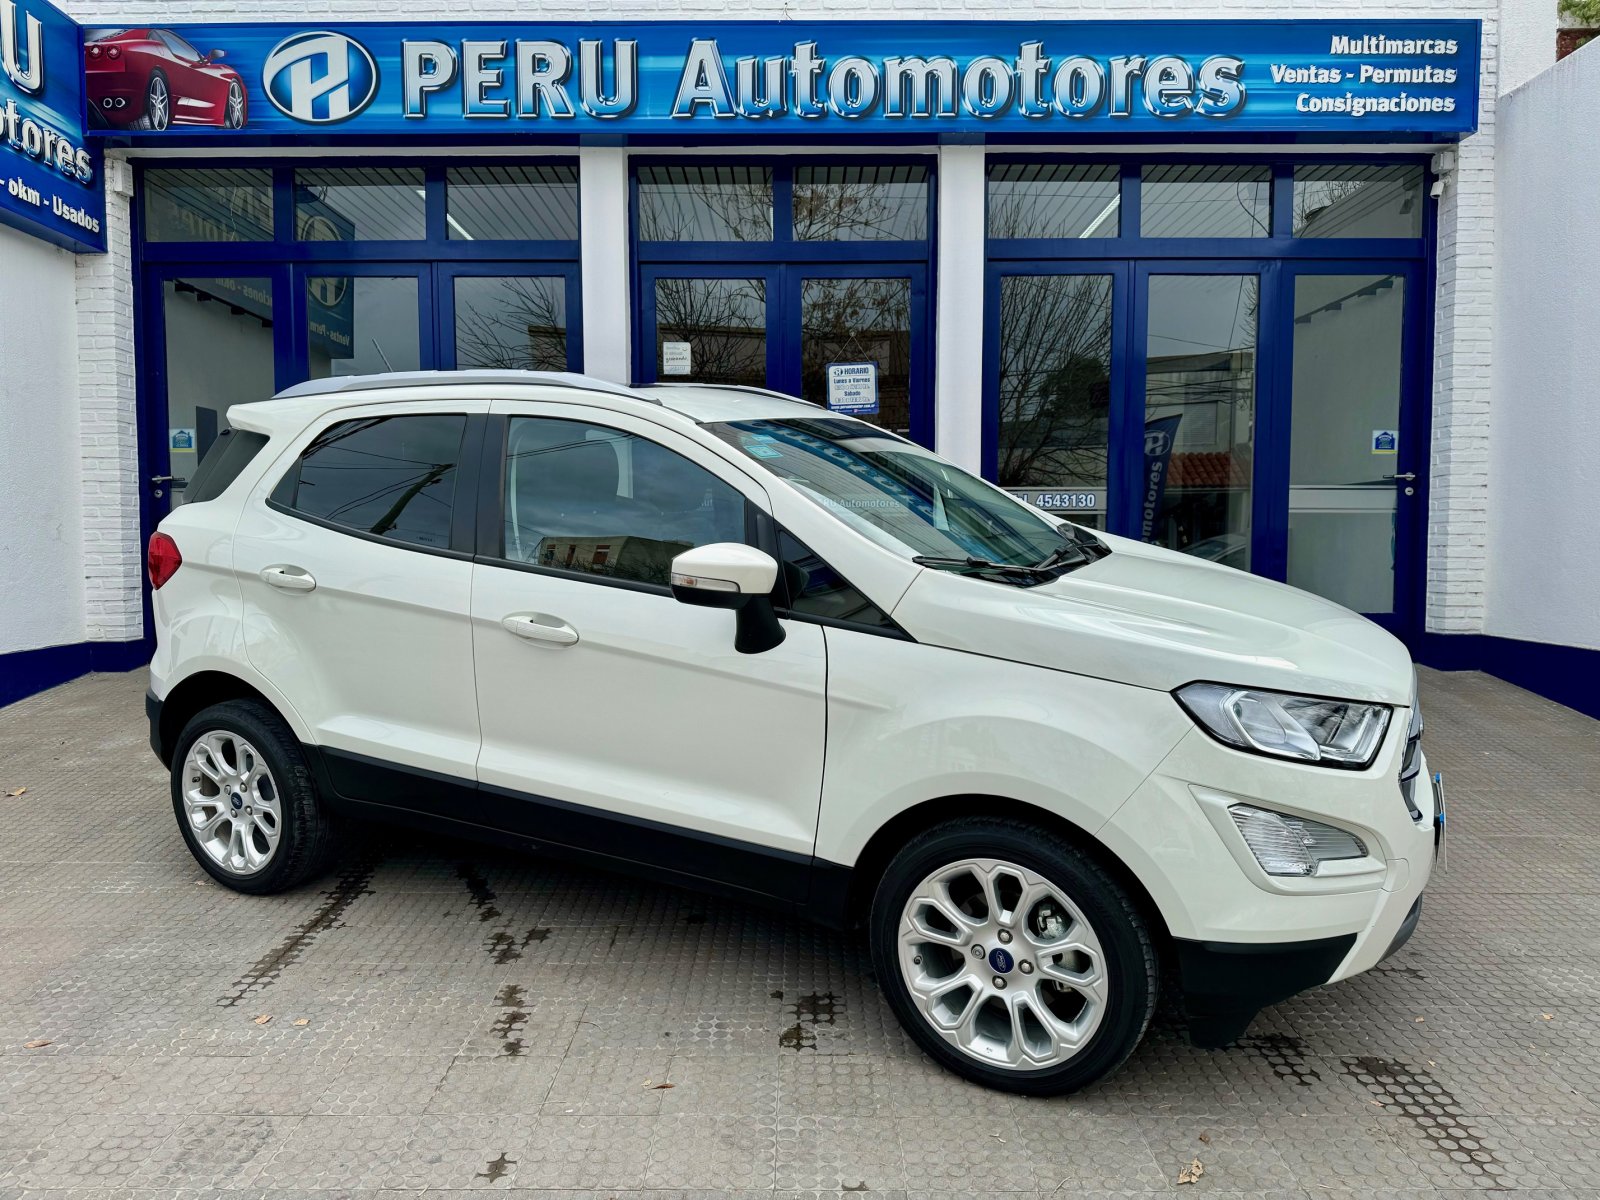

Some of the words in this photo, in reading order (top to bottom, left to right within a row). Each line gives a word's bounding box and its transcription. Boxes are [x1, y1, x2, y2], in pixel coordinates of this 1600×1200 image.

[1329, 34, 1458, 54] Multimarcas
[402, 38, 638, 118] PERU
[670, 38, 1247, 118] Automotores
[1270, 64, 1341, 83] Ventas
[1358, 64, 1457, 84] Permutas
[1296, 92, 1456, 116] Consignaciones
[52, 193, 100, 233] Usados
[844, 367, 869, 375] HORARIO
[1036, 494, 1095, 507] 4543130
